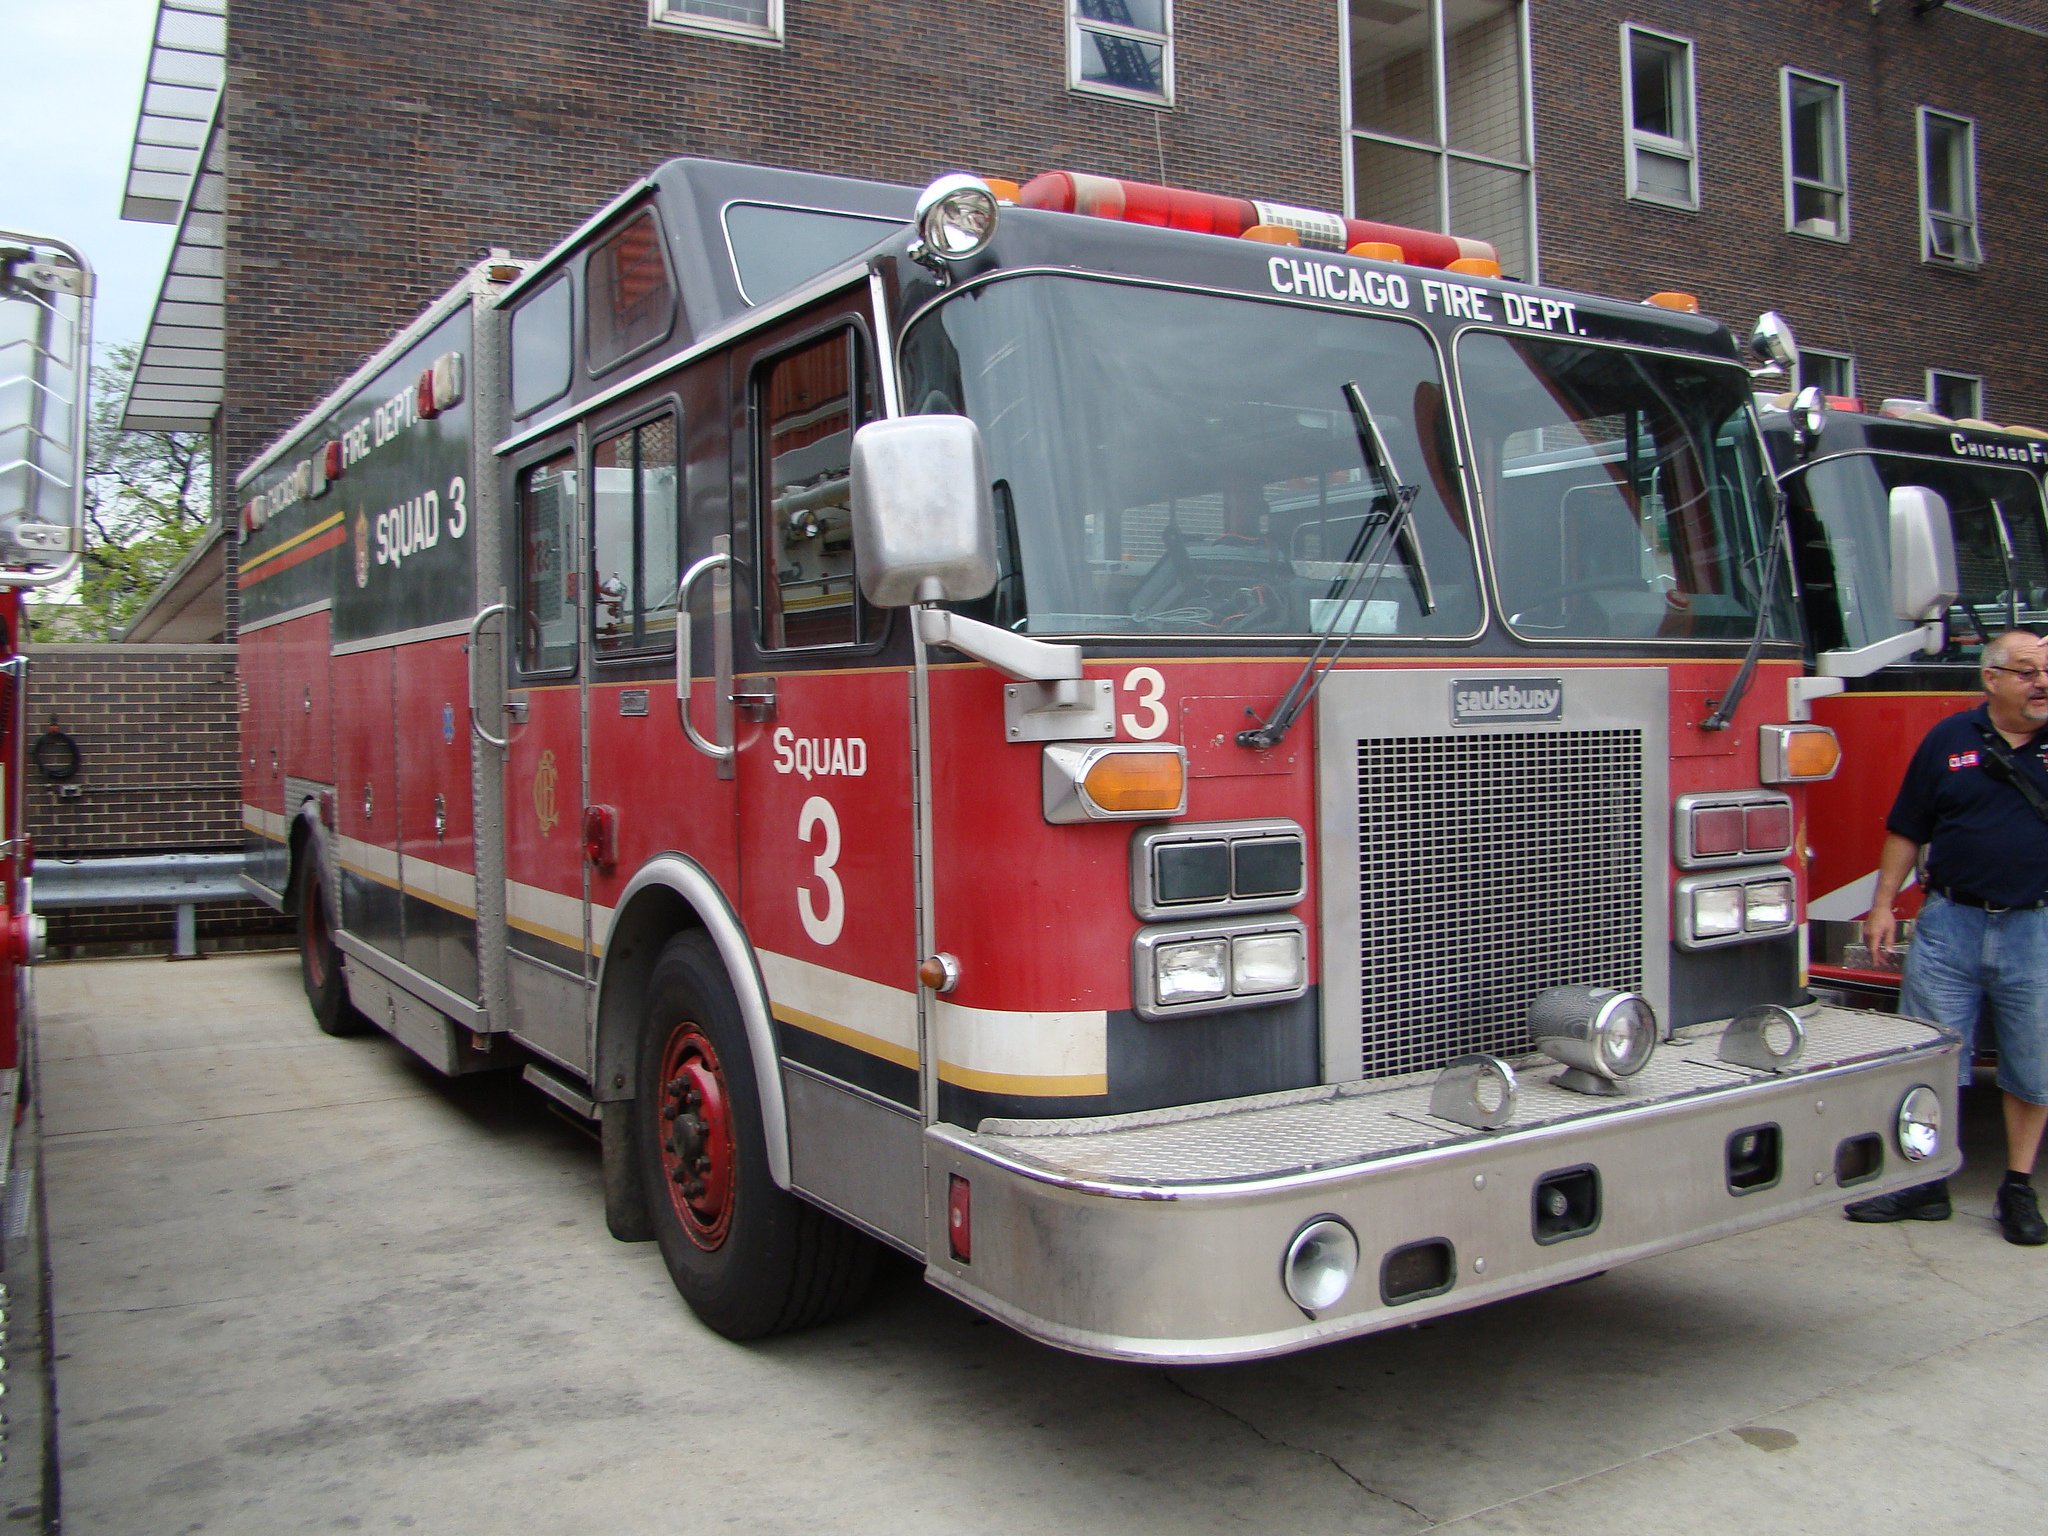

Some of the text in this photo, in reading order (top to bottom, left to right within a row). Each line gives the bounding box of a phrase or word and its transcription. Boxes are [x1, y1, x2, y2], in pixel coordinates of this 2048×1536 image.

[1268, 257, 1587, 336] CHICAGO FIRE DEPT.
[342, 417, 371, 469] FIRE
[1950, 433, 2028, 462] CHICAGO
[376, 490, 439, 569] SQUAD
[449, 476, 467, 539] 3
[1121, 666, 1169, 740] 3
[773, 727, 868, 781] SQUAD
[797, 796, 845, 946] 3
